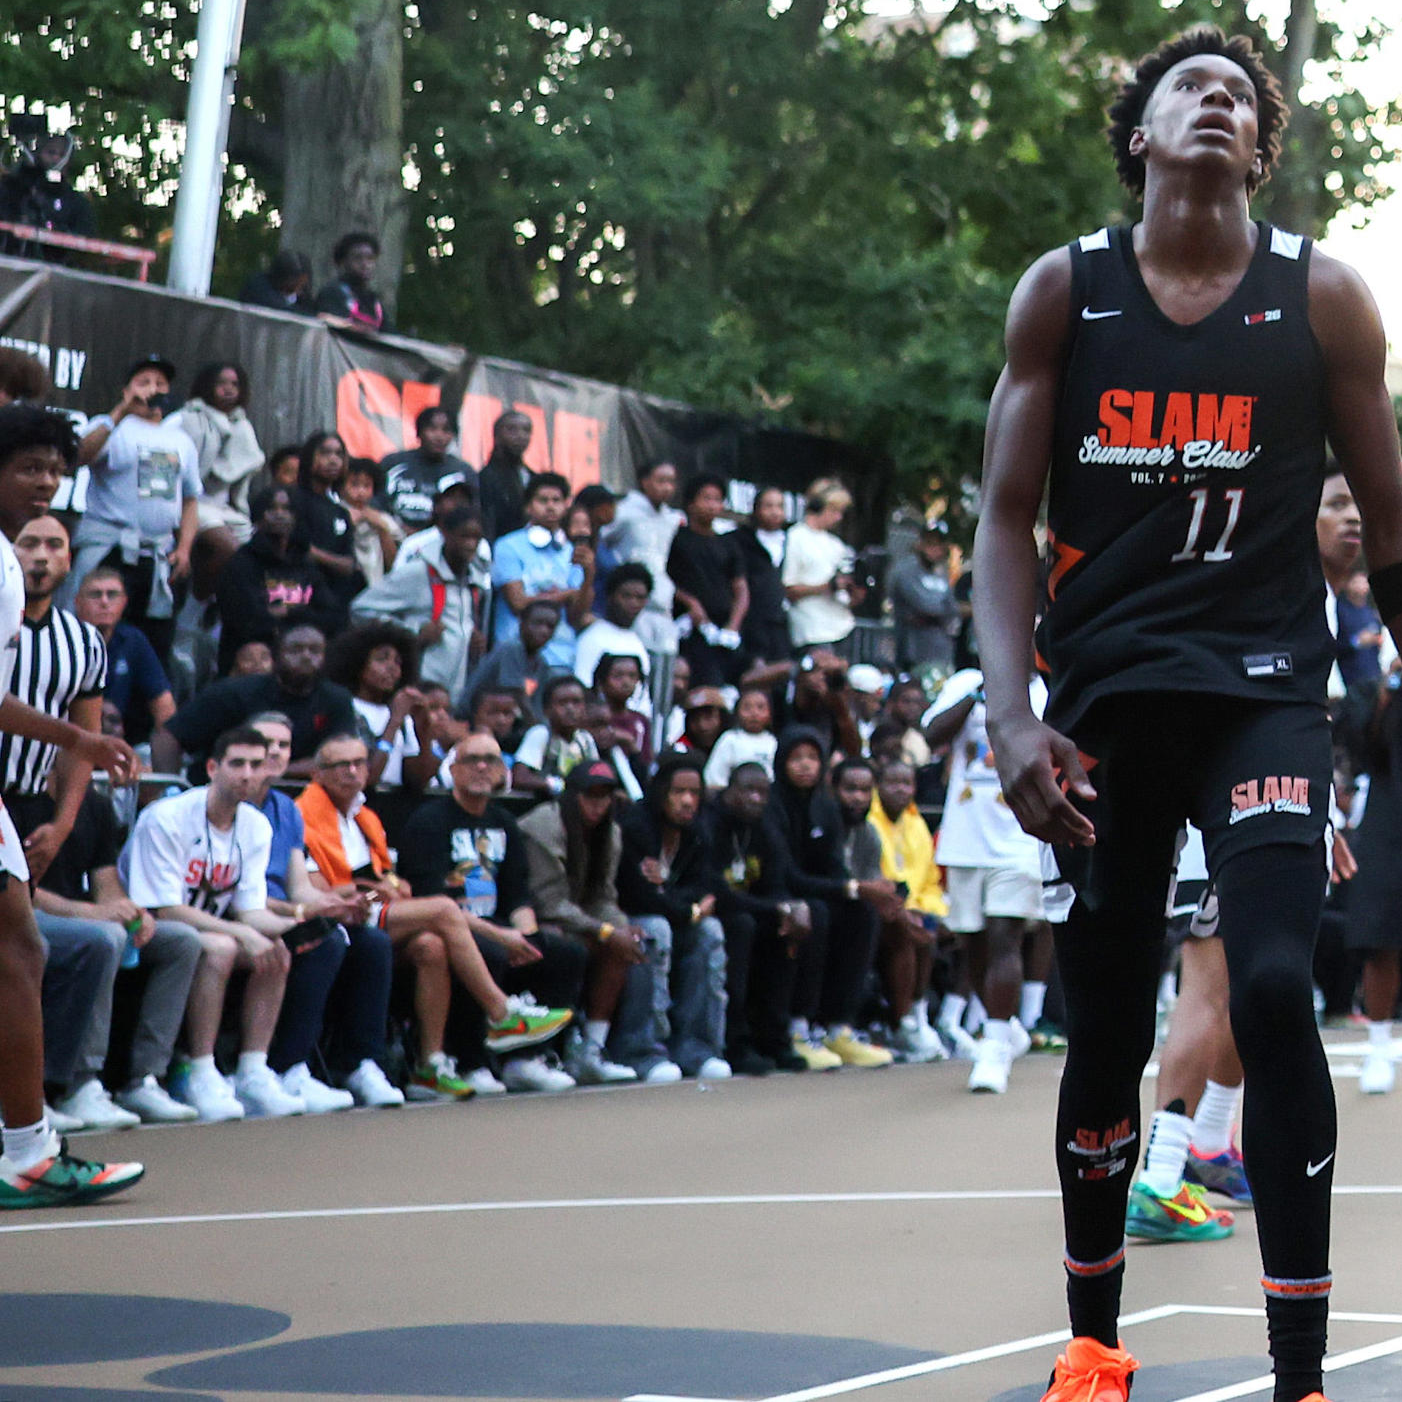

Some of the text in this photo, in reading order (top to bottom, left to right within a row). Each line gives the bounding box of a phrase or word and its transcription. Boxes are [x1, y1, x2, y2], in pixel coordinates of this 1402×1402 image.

[55, 348, 87, 390] BY
[1097, 388, 1257, 453] SLAM
[1078, 434, 1262, 470] Summer Classi
[1131, 472, 1154, 484] VOL.
[1158, 473, 1165, 483] 7
[1171, 487, 1245, 563] 11
[1275, 658, 1289, 671] XL
[1231, 775, 1310, 812] SLAM
